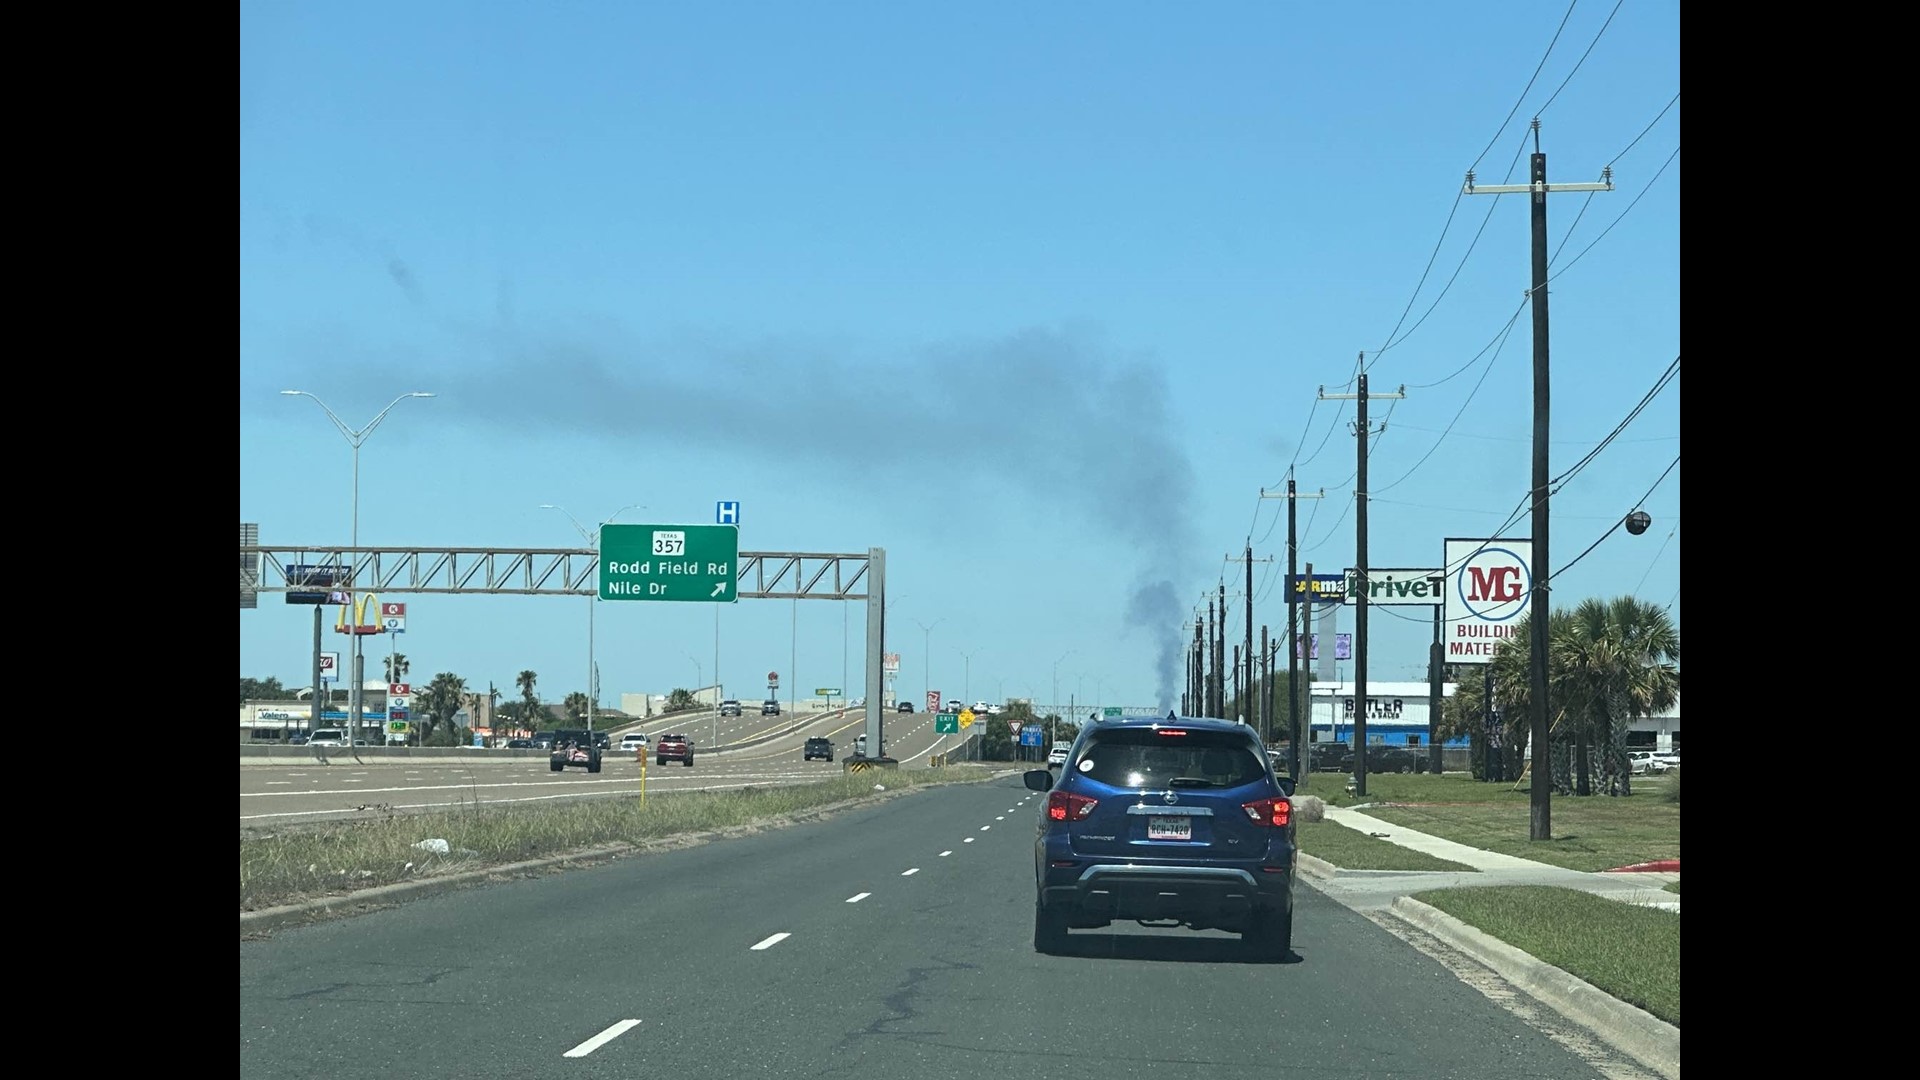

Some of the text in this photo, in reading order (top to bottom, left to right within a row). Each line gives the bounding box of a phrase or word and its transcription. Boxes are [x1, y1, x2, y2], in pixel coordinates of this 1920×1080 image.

[719, 502, 737, 523] H
[655, 540, 683, 553] 357
[609, 561, 728, 575] Rodd Field Rd
[608, 582, 667, 595] Nile Dr
[1467, 566, 1522, 602] MG
[1345, 699, 1403, 712] BTLER
[262, 711, 289, 719] Valero
